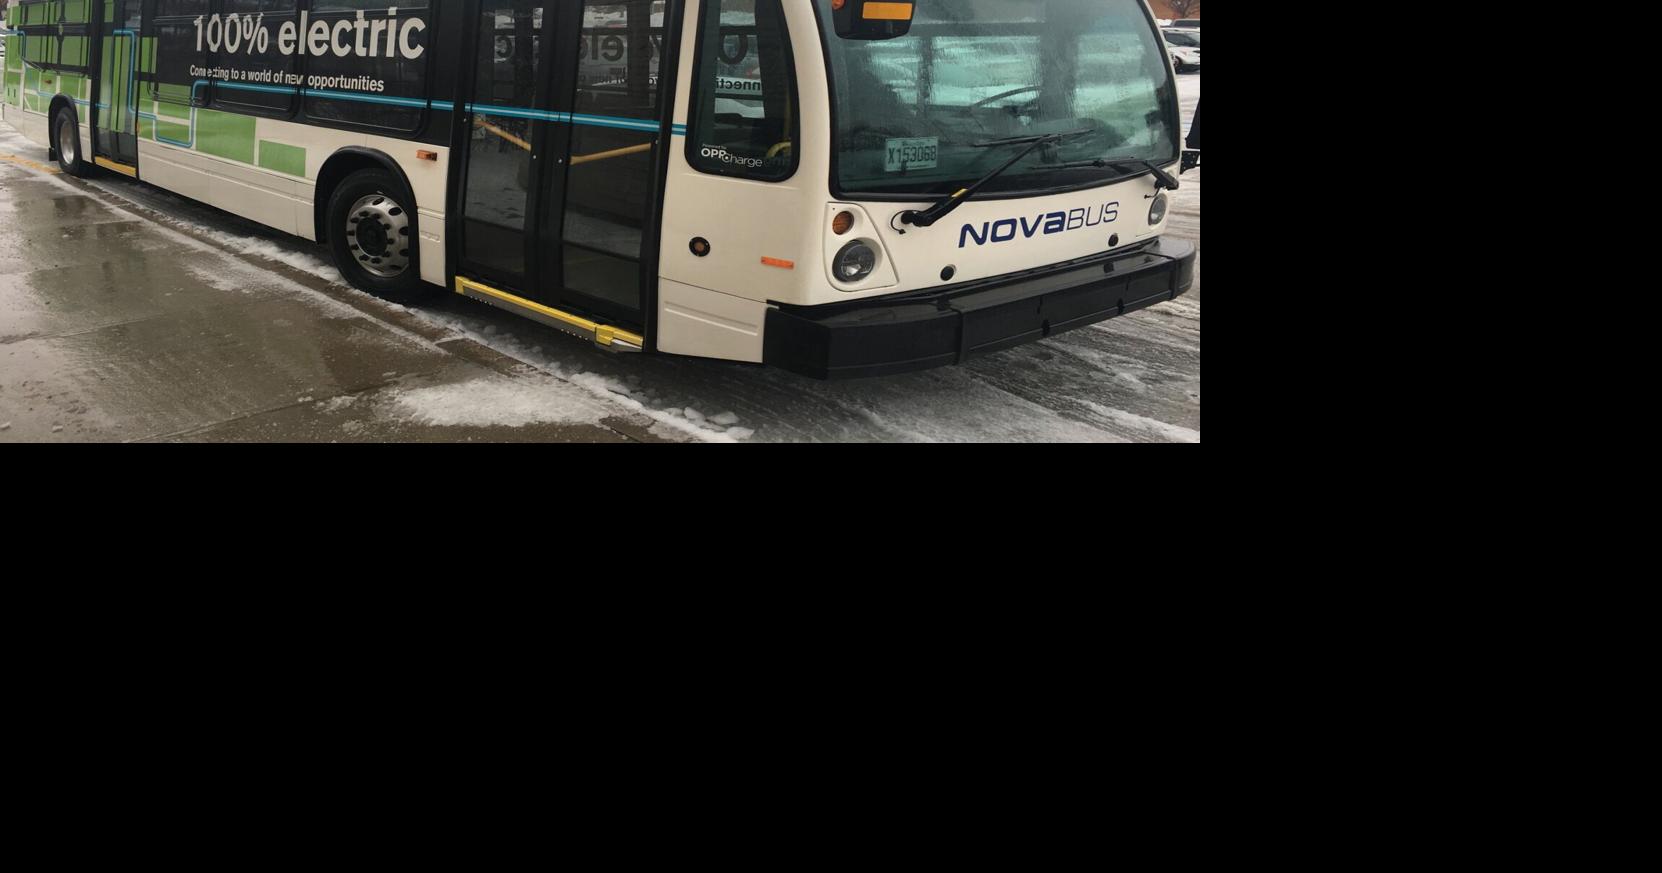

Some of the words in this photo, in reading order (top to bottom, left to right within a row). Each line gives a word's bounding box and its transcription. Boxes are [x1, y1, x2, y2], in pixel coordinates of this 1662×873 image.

[193, 12, 269, 55] 100%
[278, 6, 426, 60] electric
[231, 67, 239, 80] to
[241, 70, 246, 80] a
[247, 69, 271, 83] world
[273, 69, 284, 84] of
[285, 73, 304, 85] new
[307, 74, 385, 93] opportunities
[888, 145, 937, 165] X153068
